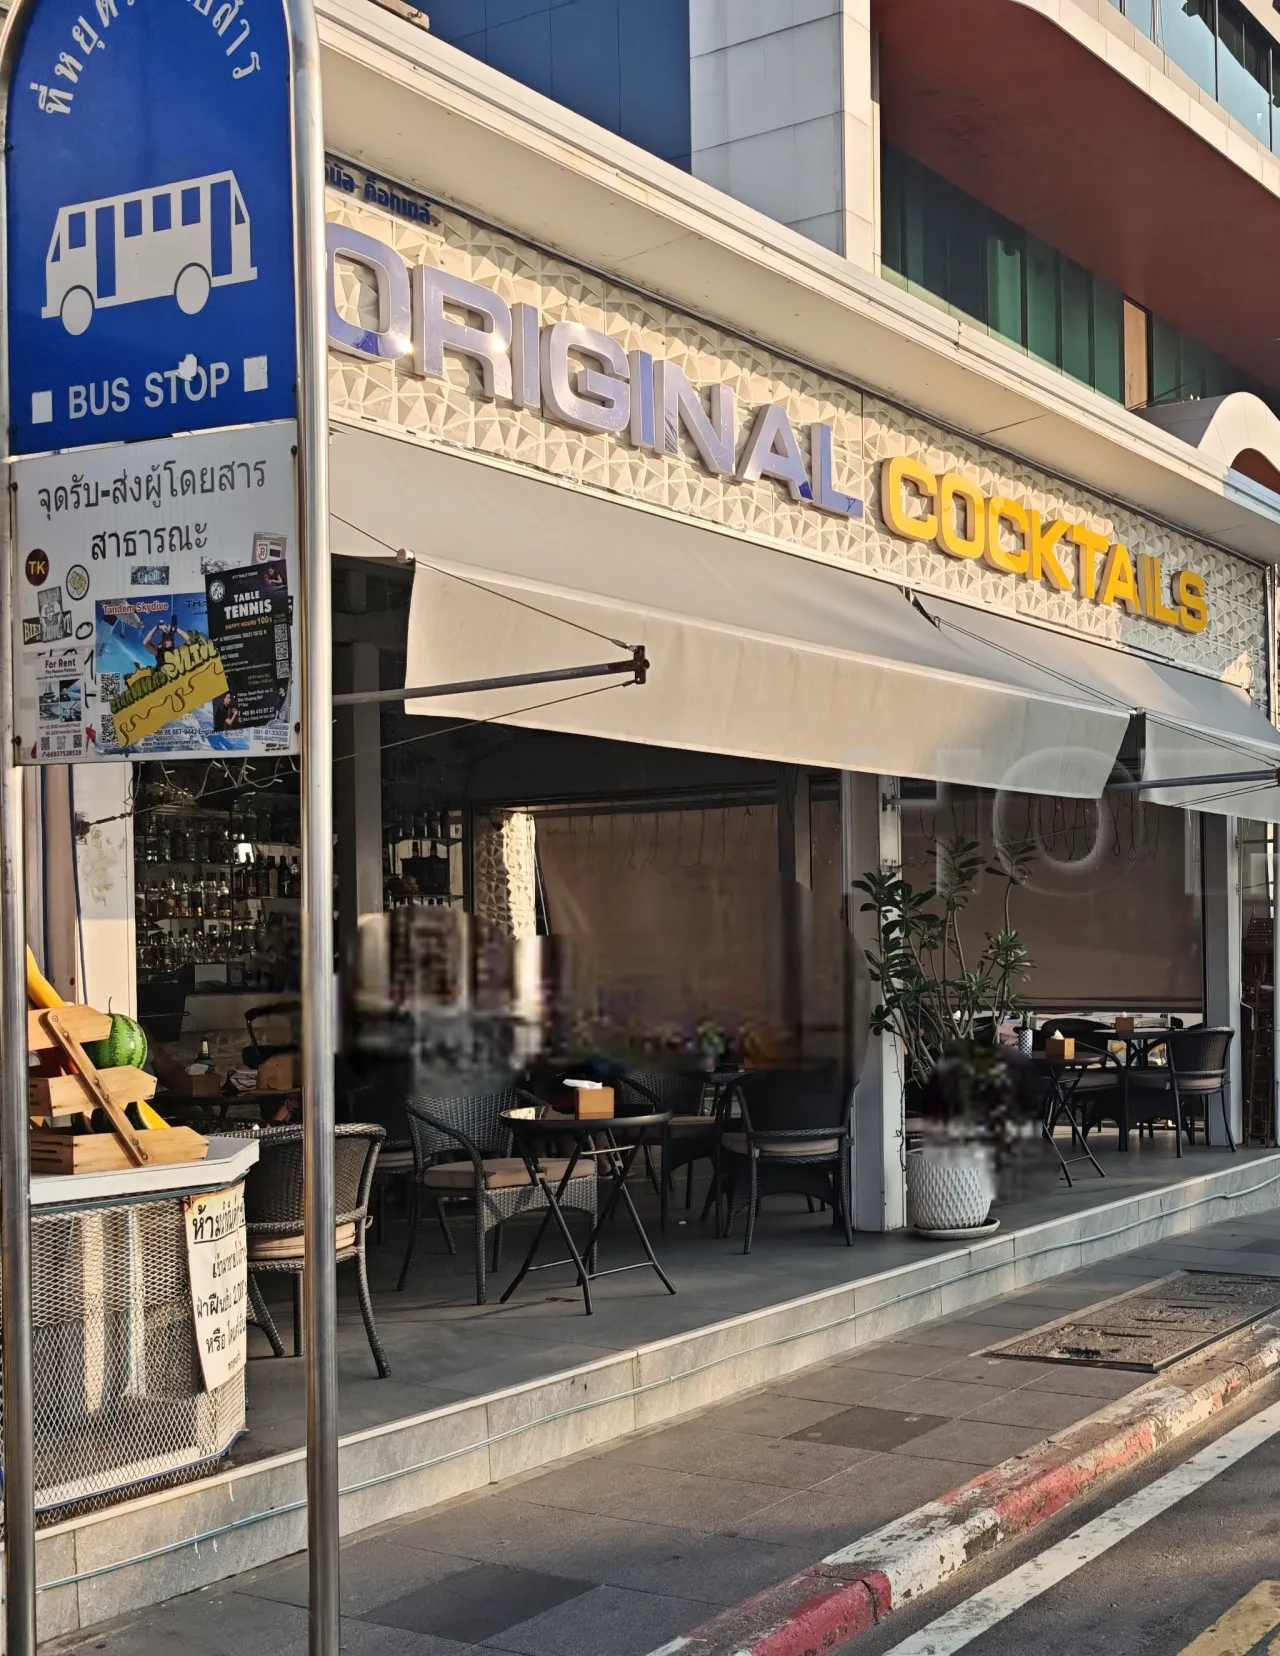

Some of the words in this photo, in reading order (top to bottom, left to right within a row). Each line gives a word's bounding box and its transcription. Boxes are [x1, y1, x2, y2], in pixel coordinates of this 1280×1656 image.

[325, 222, 864, 518] ORIGINAL
[69, 377, 130, 420] BUS
[144, 362, 230, 406] STOP
[38, 459, 267, 521] จุดรับ-ส่งผู้โดยสาร
[91, 522, 208, 561] สาธารณะ
[881, 456, 1208, 634] COCKTAILS
[29, 560, 46, 575] TK
[102, 604, 135, 615] Tandem
[136, 601, 169, 614] Skydive
[223, 599, 272, 620] TENNIS
[233, 590, 260, 602] TABLE
[45, 660, 57, 669] For
[59, 658, 76, 668] Rent
